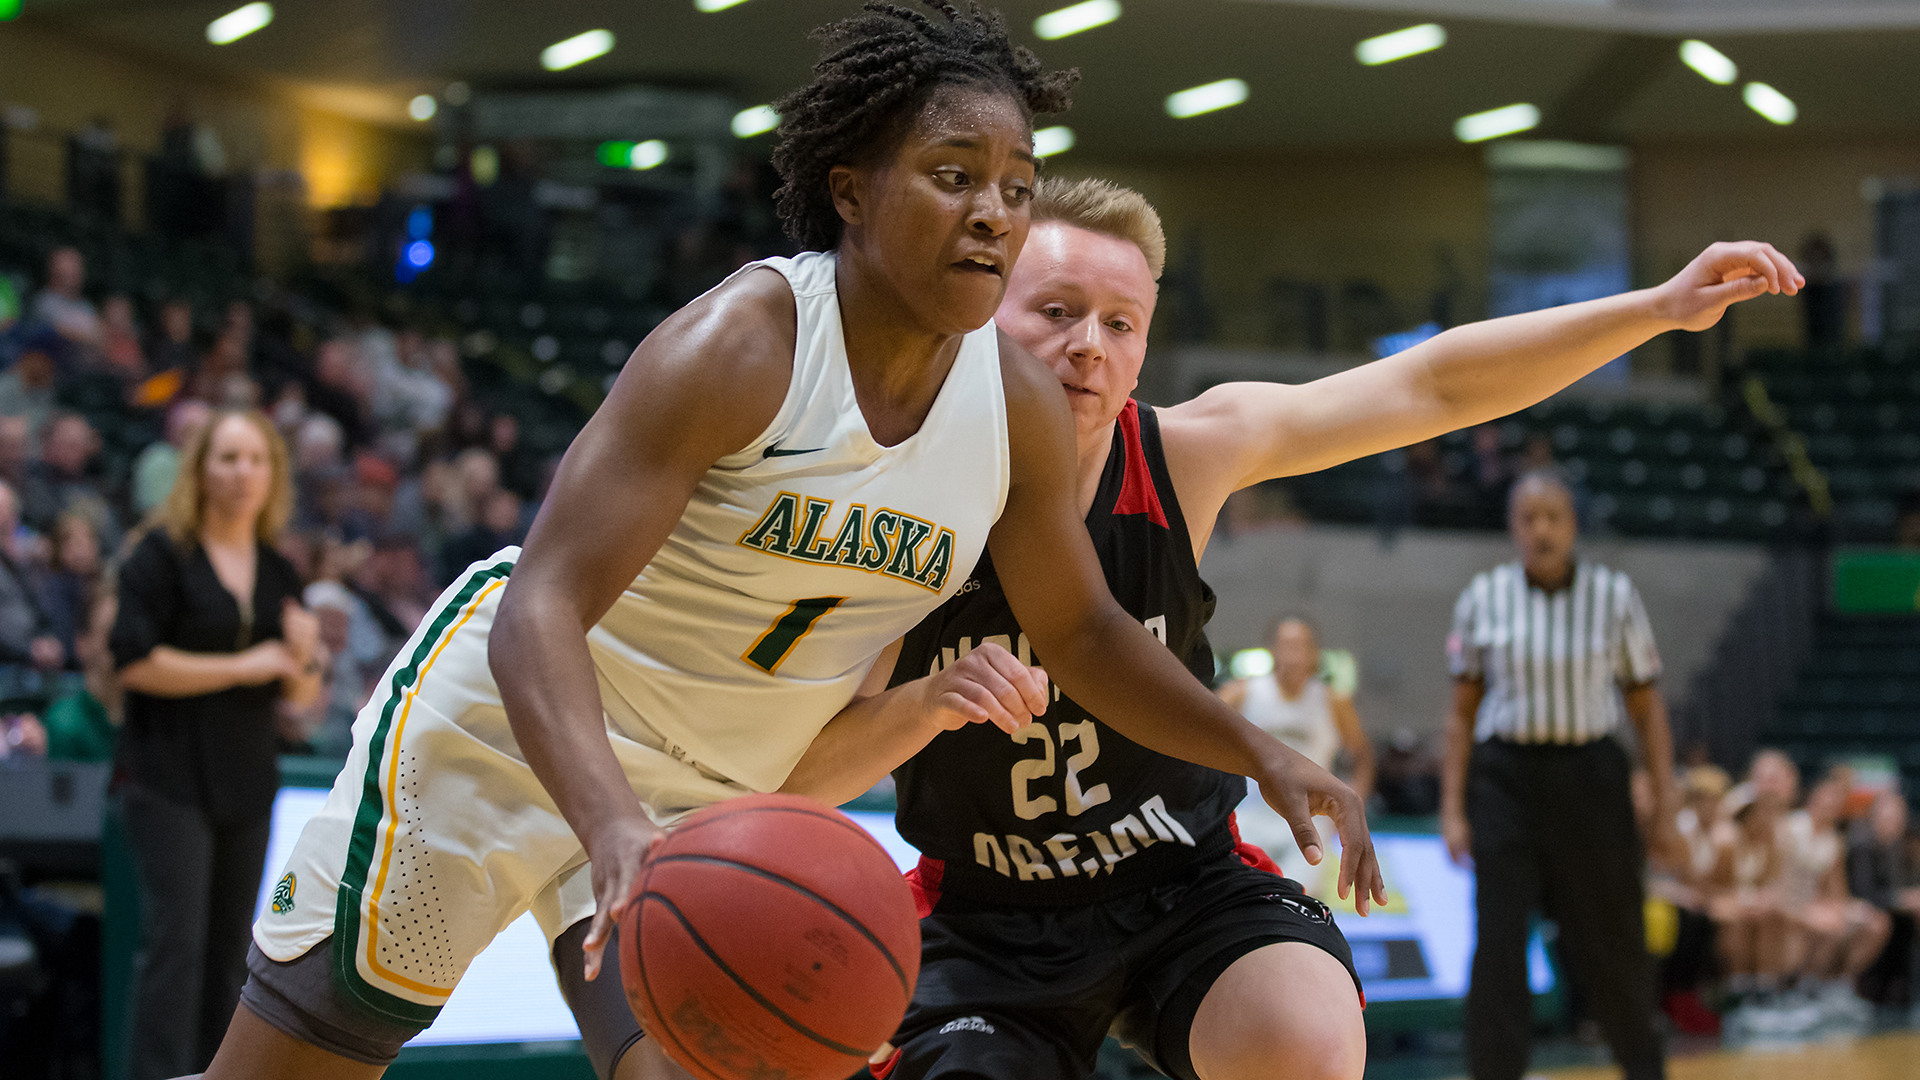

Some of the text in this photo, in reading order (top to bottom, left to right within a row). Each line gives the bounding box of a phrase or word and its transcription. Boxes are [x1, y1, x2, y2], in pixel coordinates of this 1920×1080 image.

[736, 490, 956, 596] ALASKA
[740, 595, 850, 676] 1
[1011, 719, 1111, 821] 22
